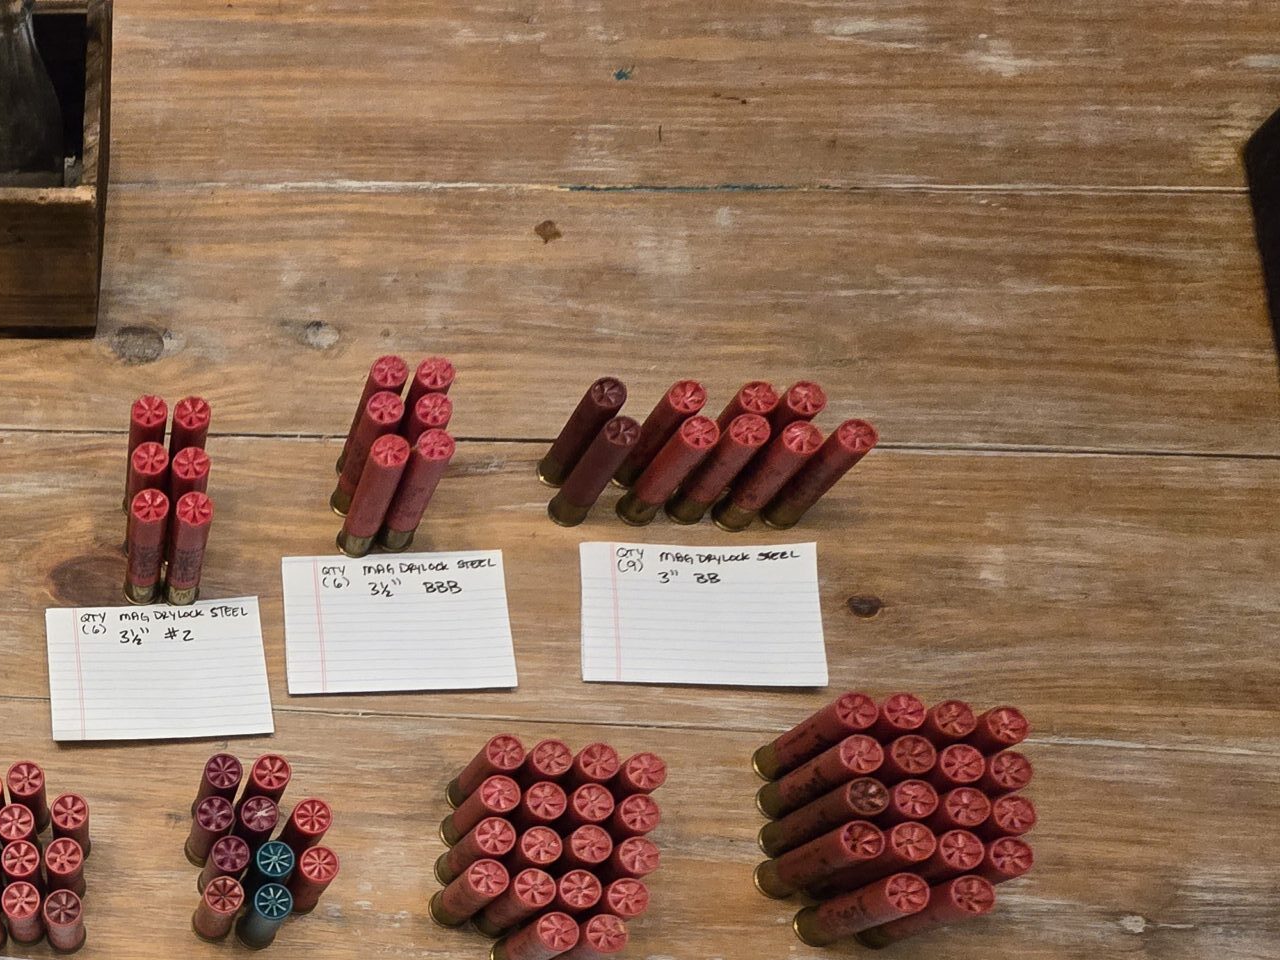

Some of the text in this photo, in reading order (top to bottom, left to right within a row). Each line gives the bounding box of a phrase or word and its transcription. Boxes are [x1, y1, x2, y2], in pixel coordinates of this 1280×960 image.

[616, 547, 644, 559] QTY
[321, 565, 346, 576] QTY
[362, 563, 395, 576] MAG
[617, 559, 644, 573] (9)
[322, 577, 350, 589] (6)
[693, 572, 721, 584] BB
[422, 580, 462, 594] BBB
[80, 612, 107, 623] QTY
[119, 606, 249, 622] MAG DRYLOCK STEEL
[81, 624, 107, 635] (6)
